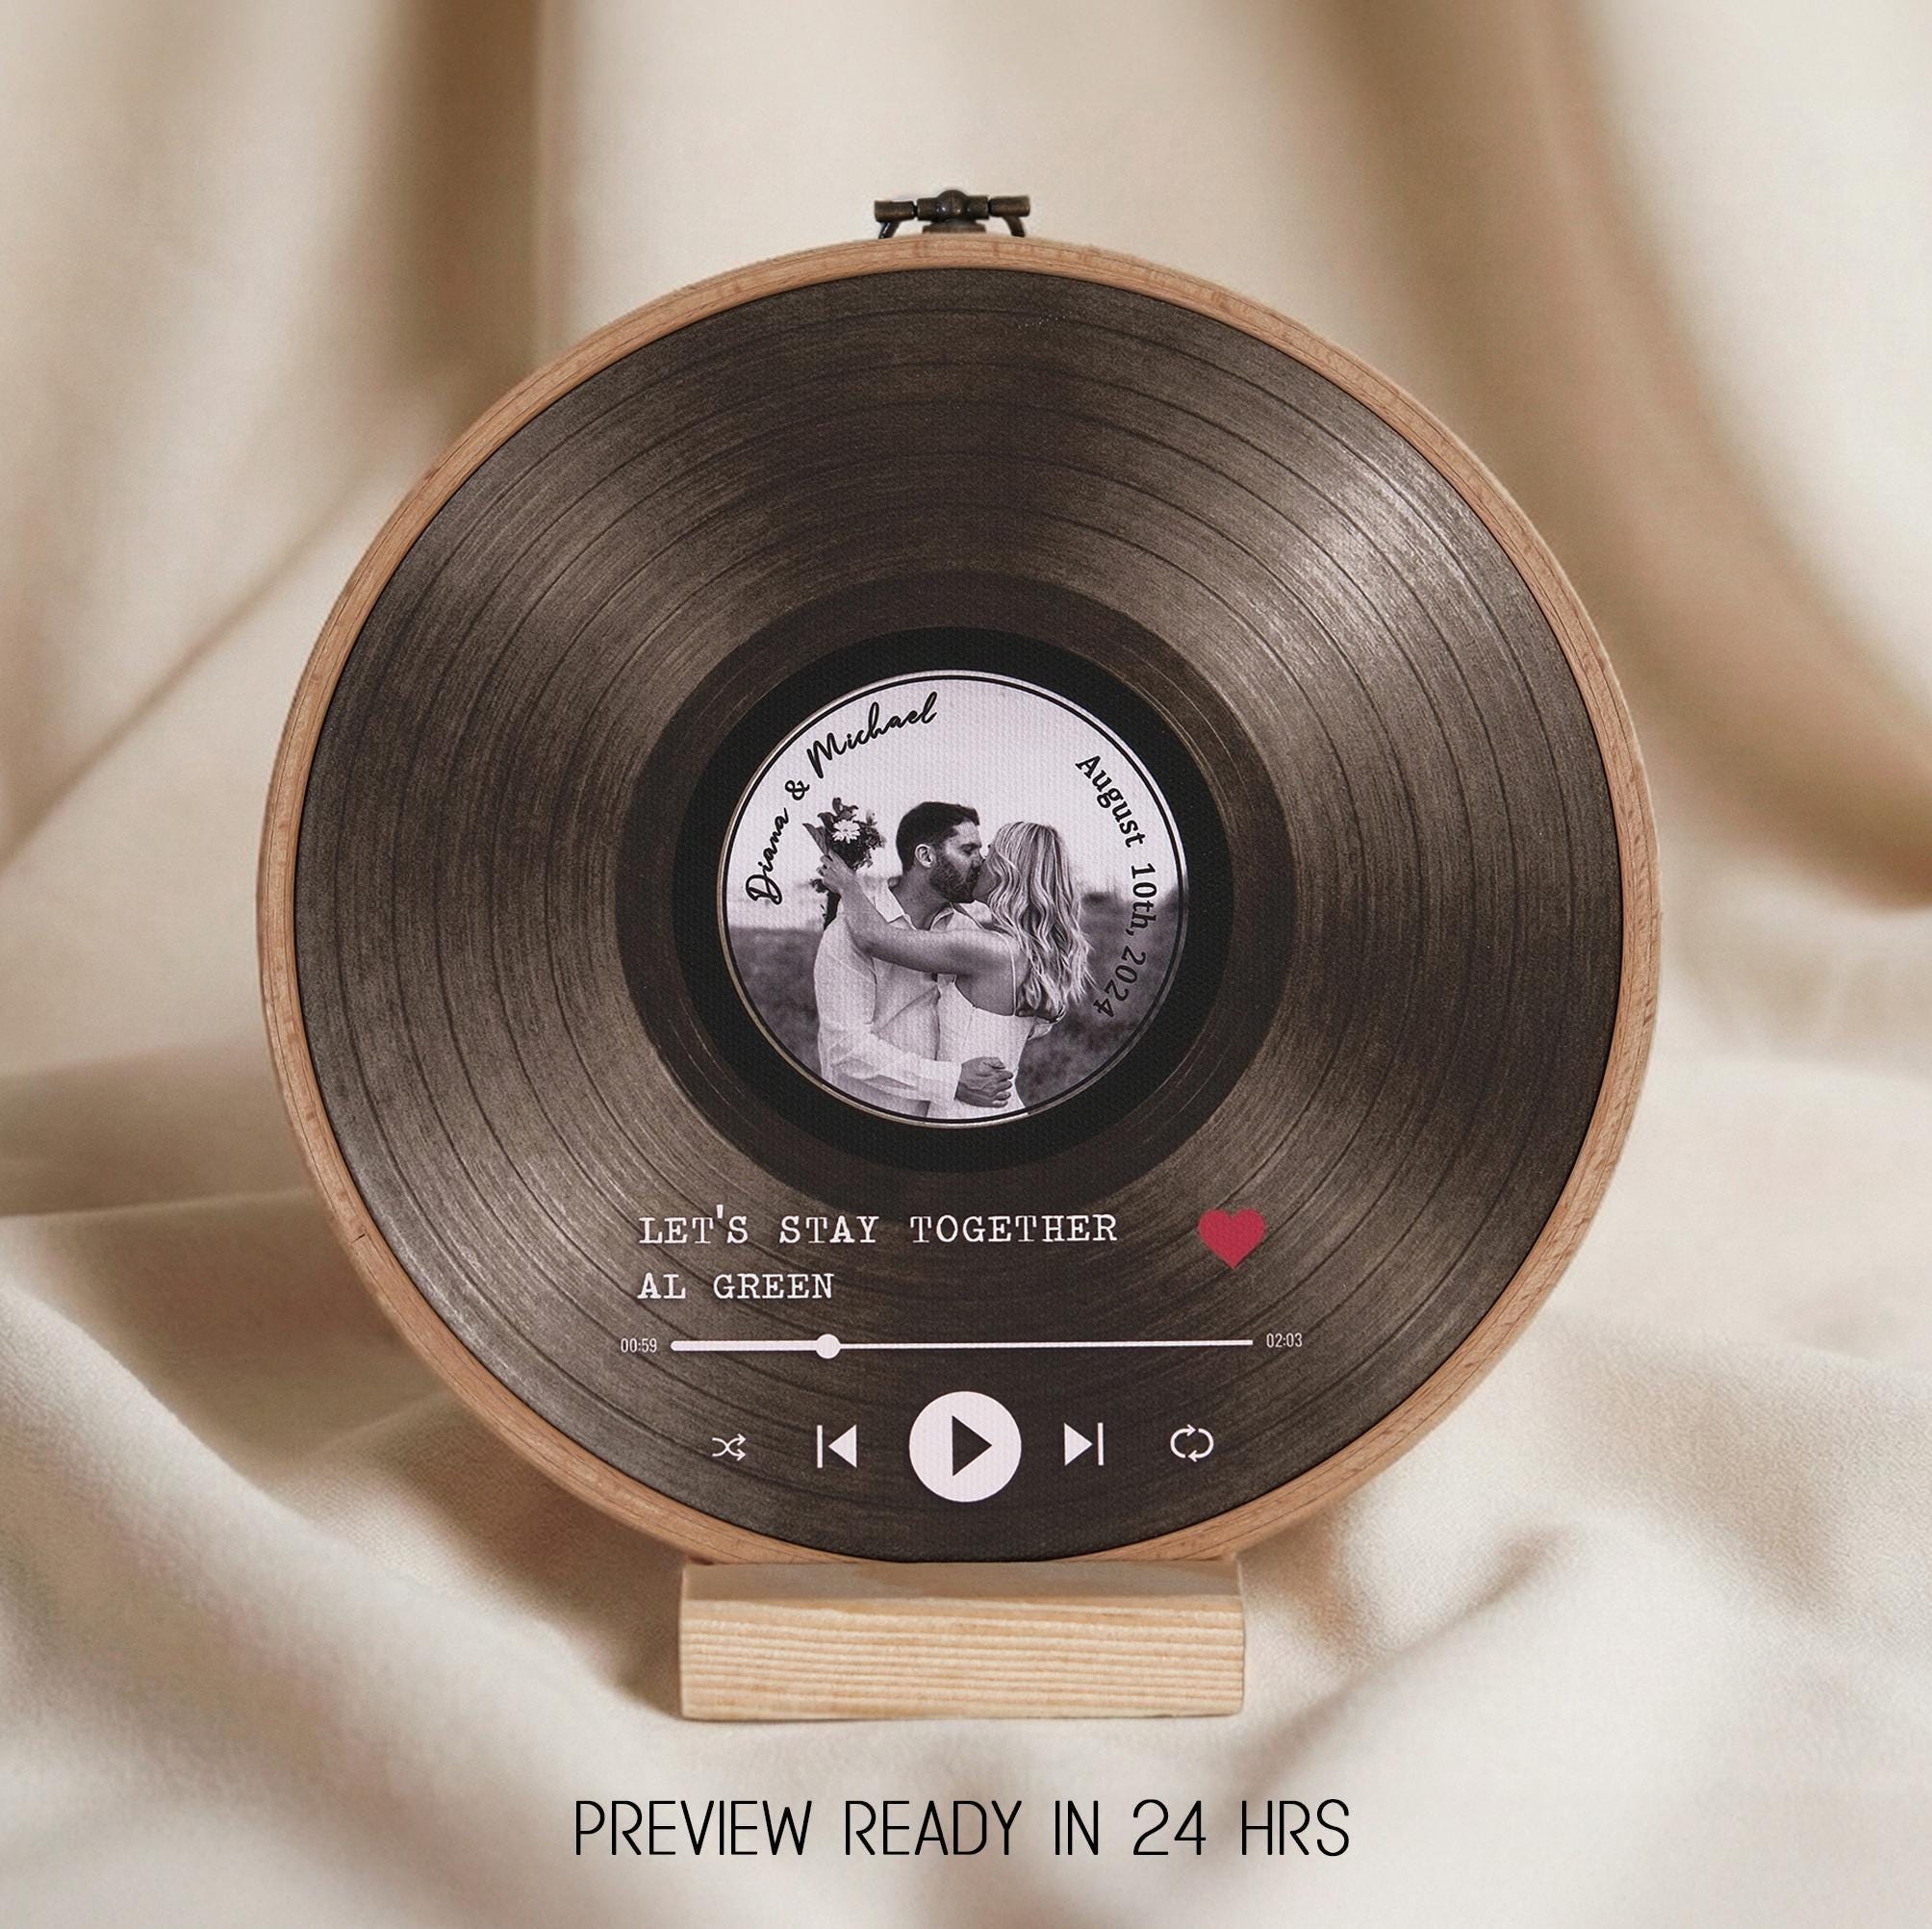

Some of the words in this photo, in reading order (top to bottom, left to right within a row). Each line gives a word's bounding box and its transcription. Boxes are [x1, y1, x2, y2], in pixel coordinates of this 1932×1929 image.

[745, 807, 789, 905] Diana
[784, 779, 810, 800] &
[806, 691, 938, 779] Michael
[1074, 754, 1146, 849] August
[1124, 862, 1157, 937] 10th,
[1092, 945, 1147, 1019] 2024
[639, 1204, 749, 1245] LET'S
[779, 1214, 879, 1244] STAY
[909, 1212, 1119, 1244] TOGETHER
[637, 1272, 687, 1301] AL
[713, 1272, 835, 1301] GREEN
[619, 1336, 658, 1355] 00:59
[1264, 1332, 1304, 1350] 02:03
